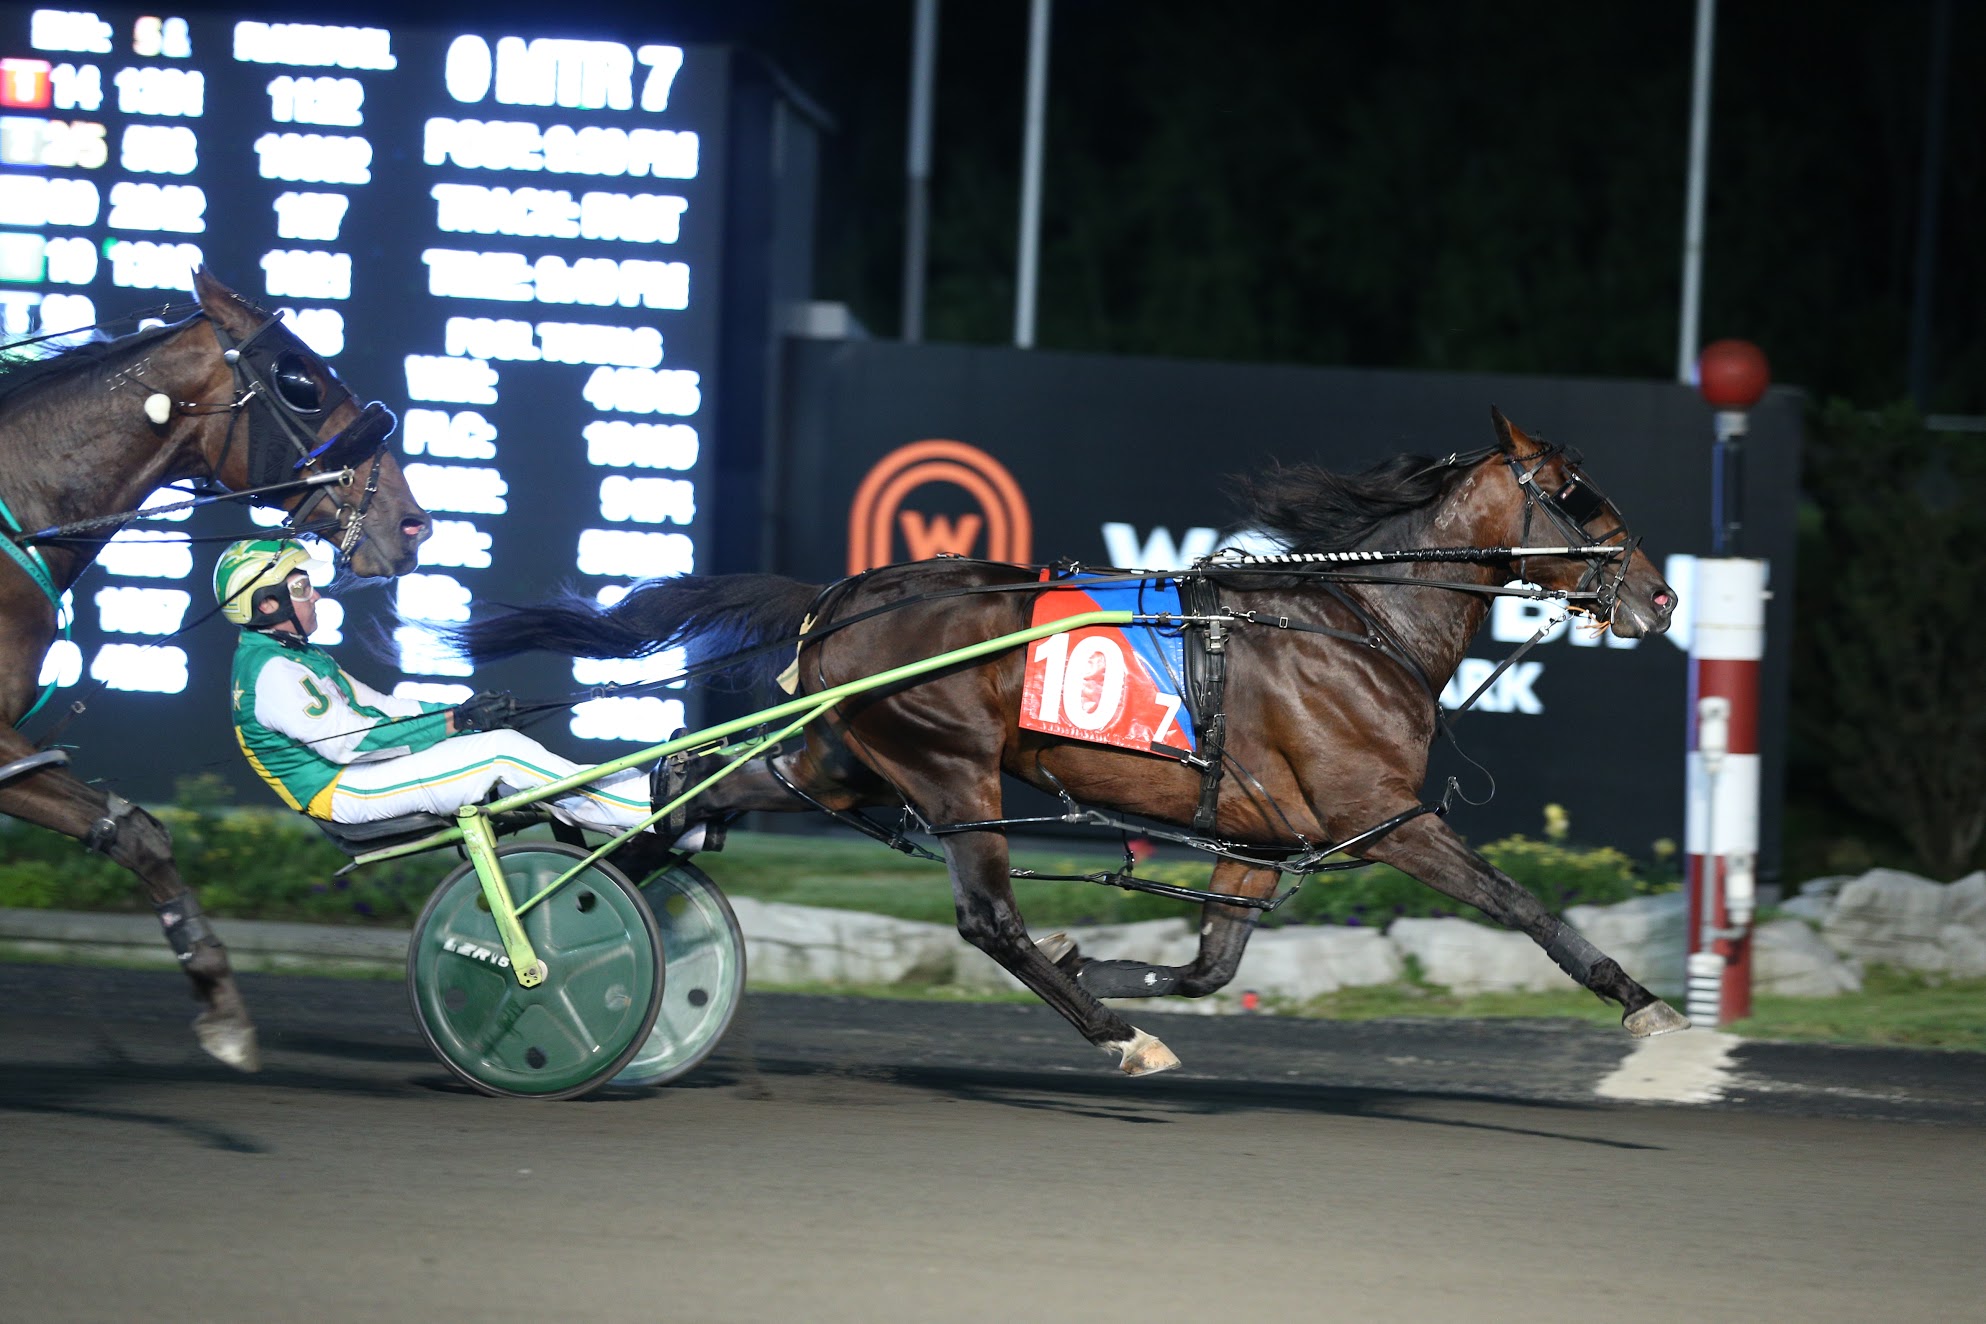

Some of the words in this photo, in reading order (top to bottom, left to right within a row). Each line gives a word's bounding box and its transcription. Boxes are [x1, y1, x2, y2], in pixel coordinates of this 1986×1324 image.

[299, 675, 333, 720] J
[1034, 632, 1125, 731] 10
[1155, 692, 1182, 742] 7
